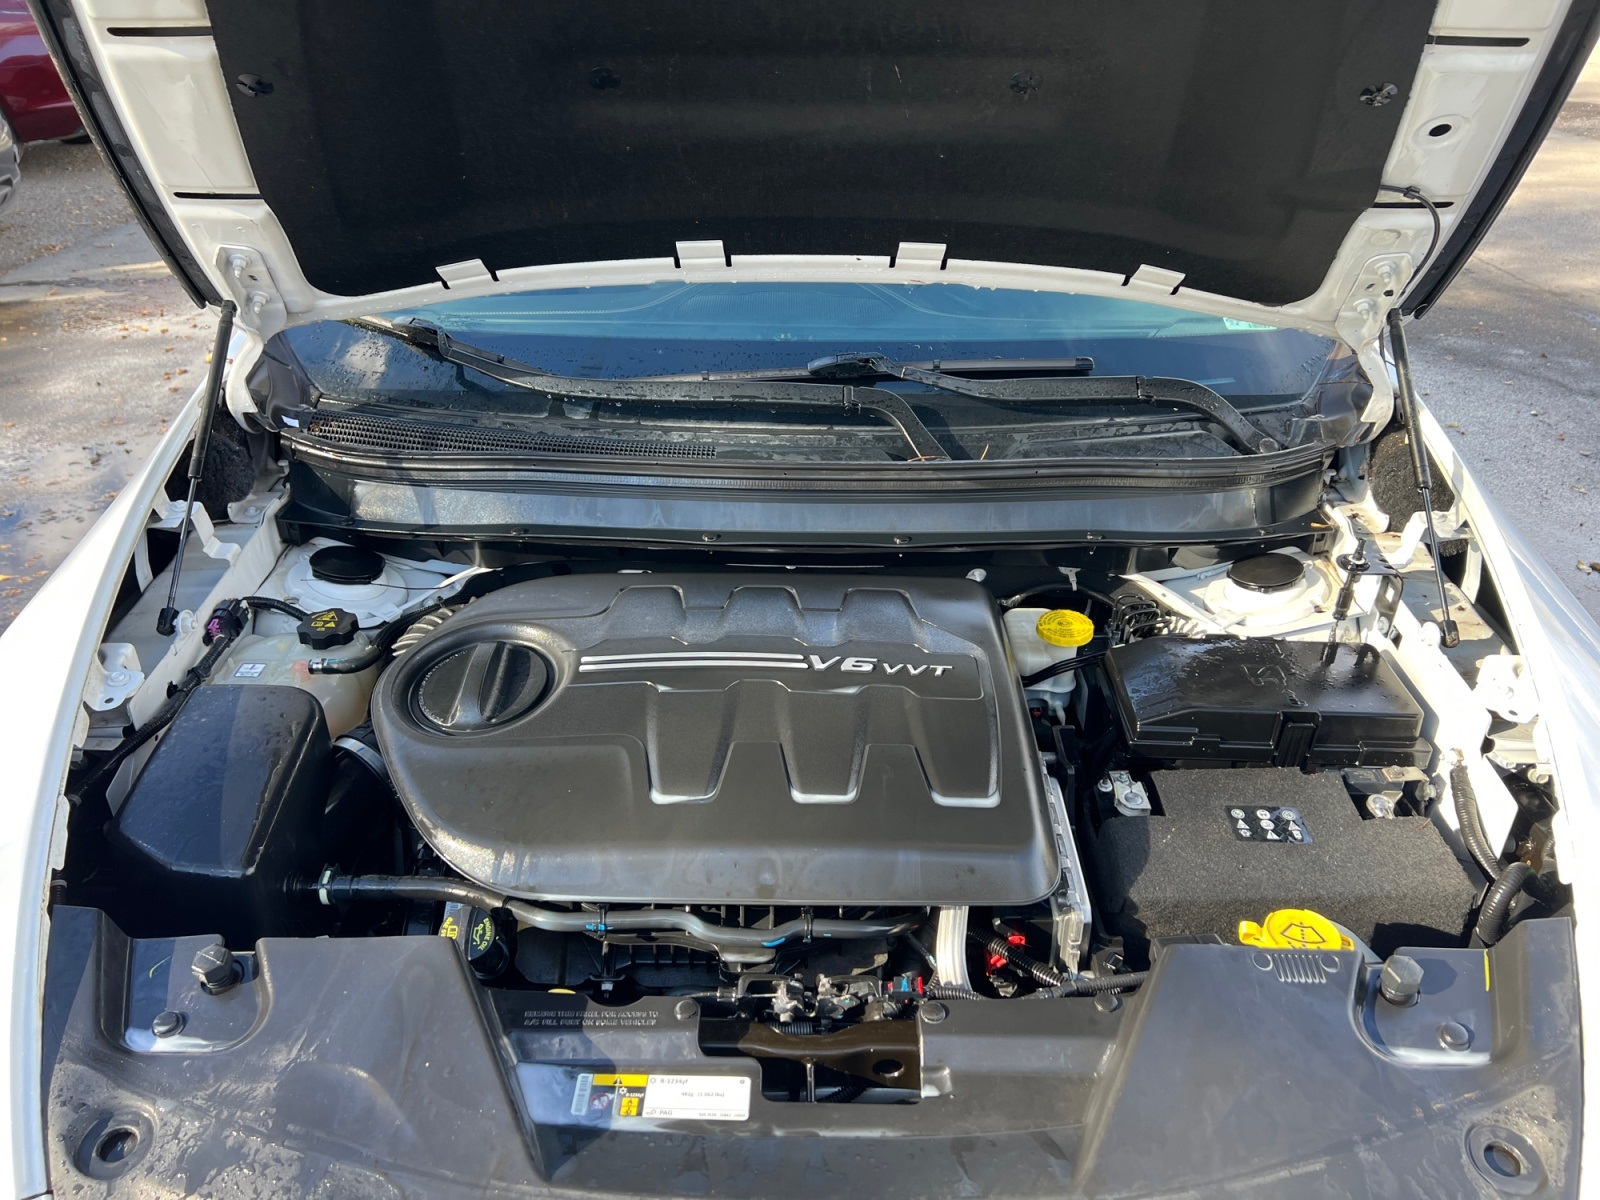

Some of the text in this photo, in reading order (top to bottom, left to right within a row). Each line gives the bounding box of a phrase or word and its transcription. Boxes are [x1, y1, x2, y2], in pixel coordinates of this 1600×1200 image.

[809, 654, 953, 677] V6 VVT
[478, 918, 492, 950] ENGINE OIL
[649, 1010, 659, 1018] TO
